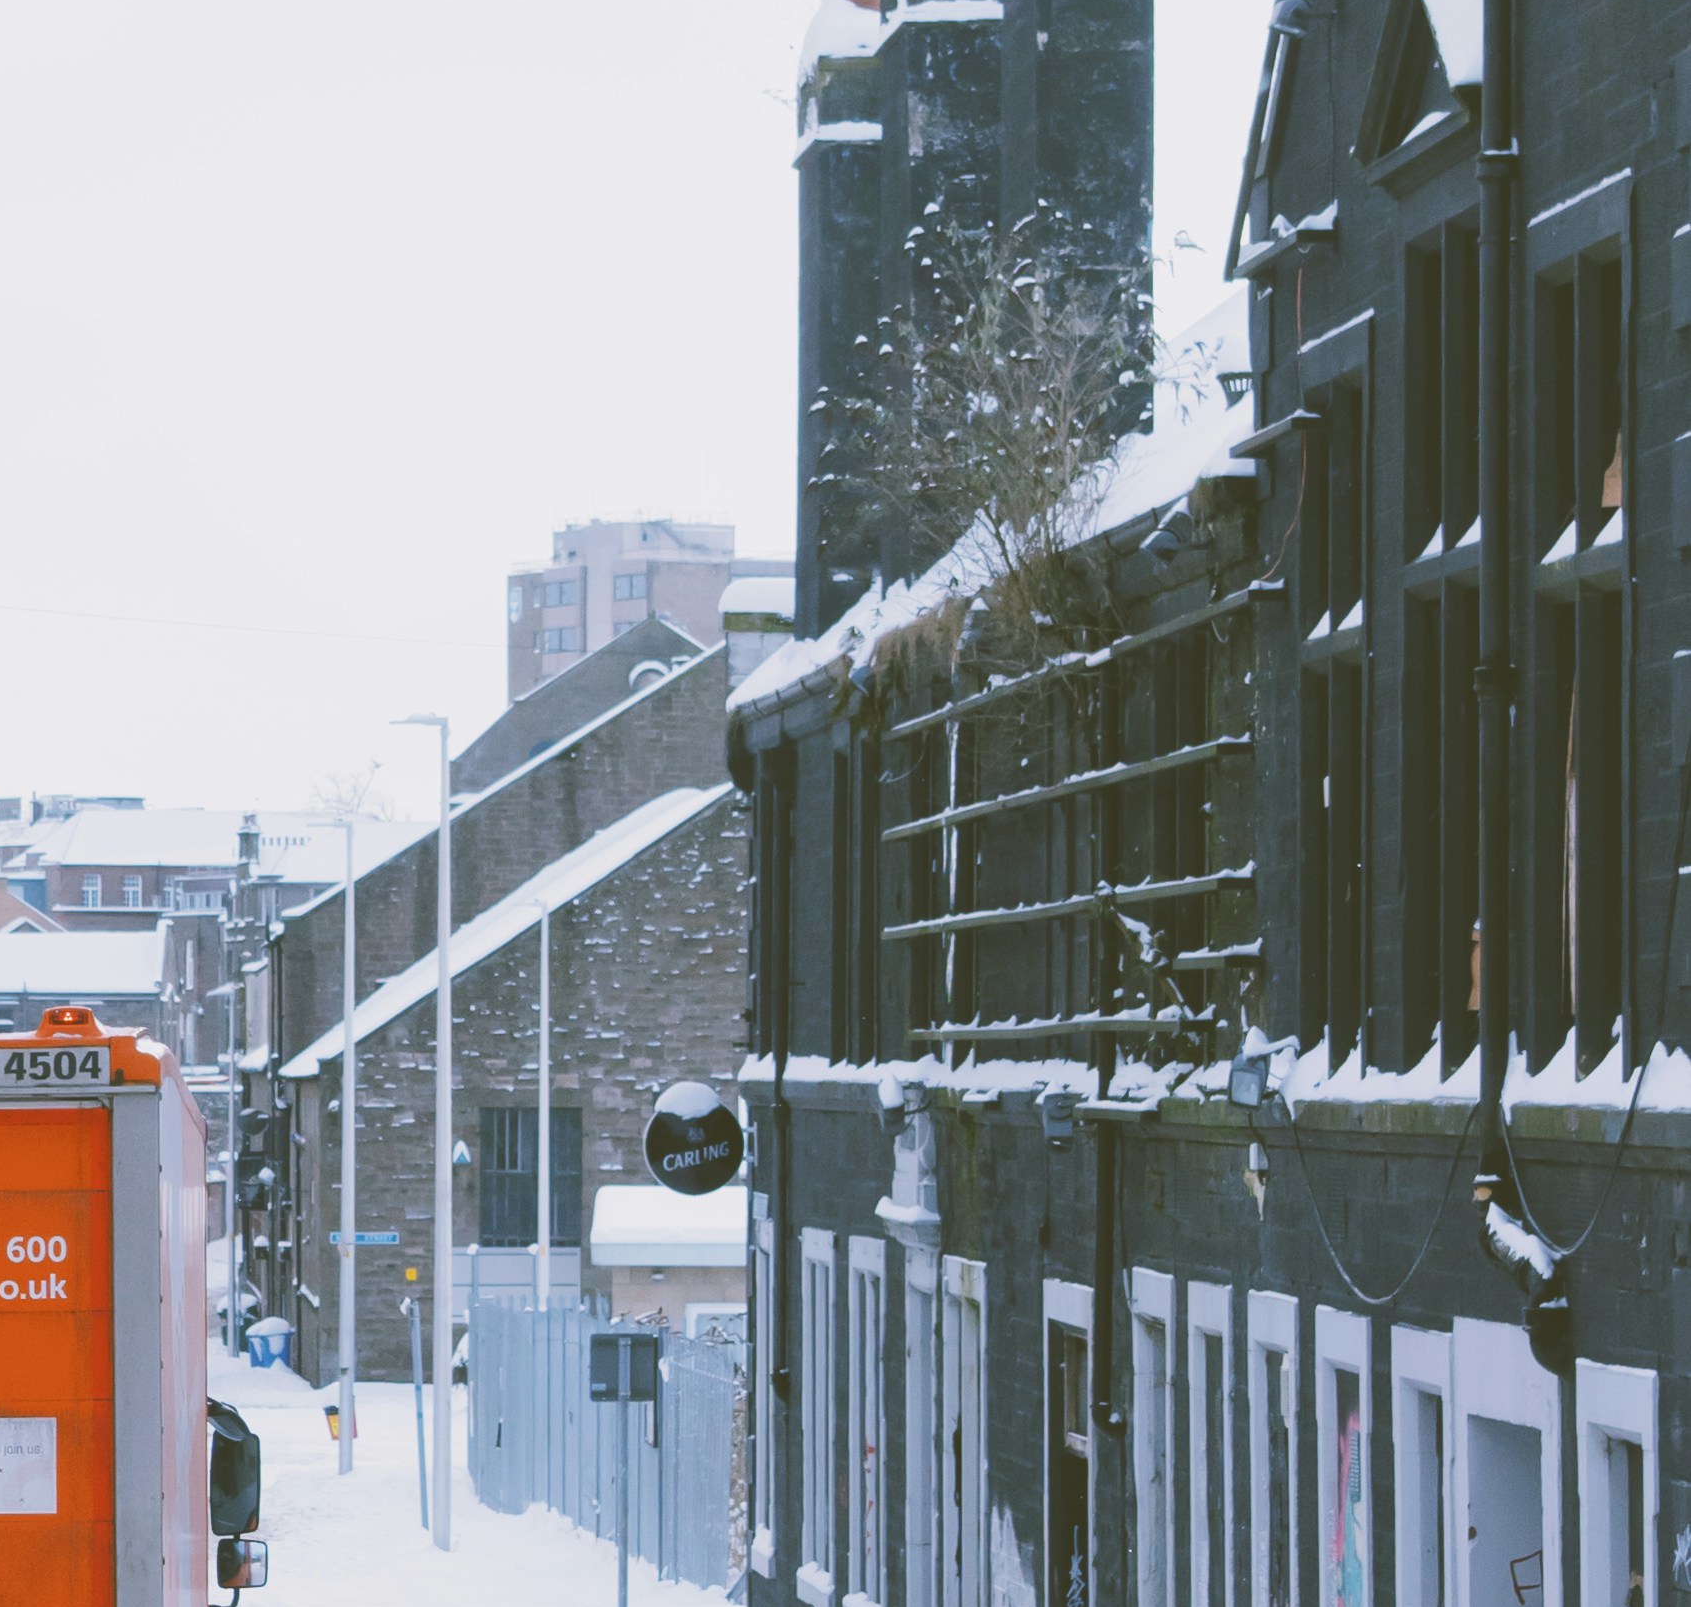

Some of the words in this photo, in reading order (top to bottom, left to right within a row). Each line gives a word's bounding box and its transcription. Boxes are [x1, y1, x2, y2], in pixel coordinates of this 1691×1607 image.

[4, 1050, 102, 1081] 4504
[662, 1141, 730, 1172] CARLING
[6, 1235, 67, 1263] 600
[3, 1444, 23, 1457] join
